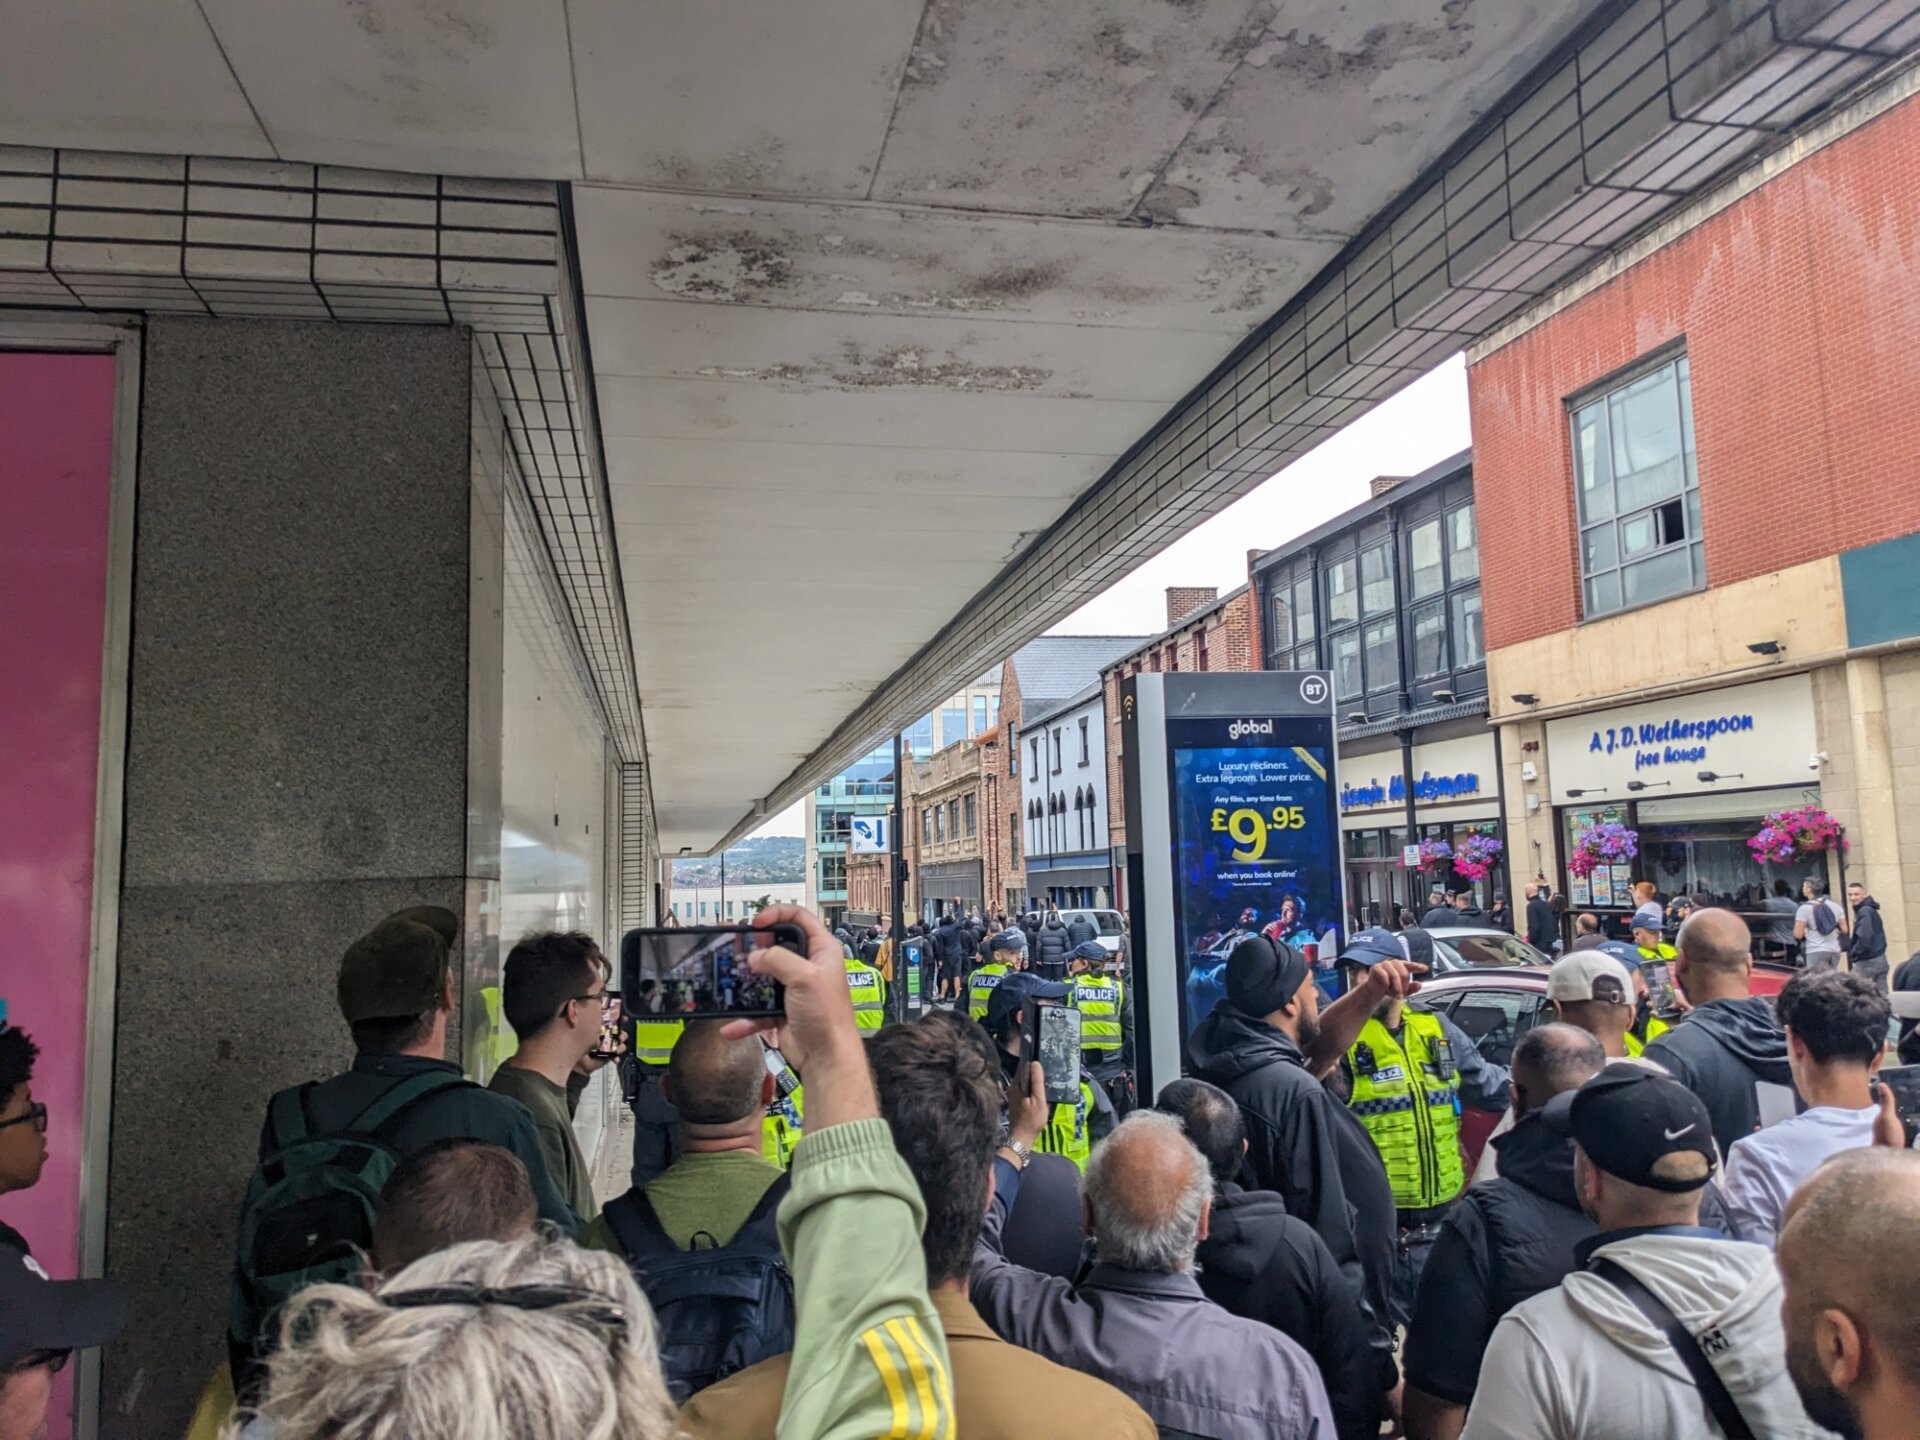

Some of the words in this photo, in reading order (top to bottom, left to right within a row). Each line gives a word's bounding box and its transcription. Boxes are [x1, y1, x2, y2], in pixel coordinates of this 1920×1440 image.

[1306, 684, 1322, 695] BT
[1229, 719, 1272, 739] global
[1589, 732, 1603, 752] A
[1638, 714, 1753, 744] Wetherspoon
[1635, 750, 1660, 771] free
[1664, 745, 1706, 764] house
[1218, 762, 1249, 771] Luxury
[1250, 761, 1289, 770] recliners.
[1196, 774, 1219, 783] Extra
[1220, 773, 1258, 784] legroom.
[1260, 773, 1287, 782] Lower
[1289, 773, 1312, 783] price.
[1214, 796, 1229, 804] Any
[1230, 794, 1245, 803] film,
[1246, 796, 1258, 804] any
[1259, 794, 1275, 802] time
[1276, 794, 1292, 802] from
[1217, 872, 1239, 880] when
[1254, 870, 1273, 878] book
[847, 973, 873, 985] OLICE
[1078, 988, 1114, 1000] POLICE
[1372, 1067, 1401, 1081] POLICE
